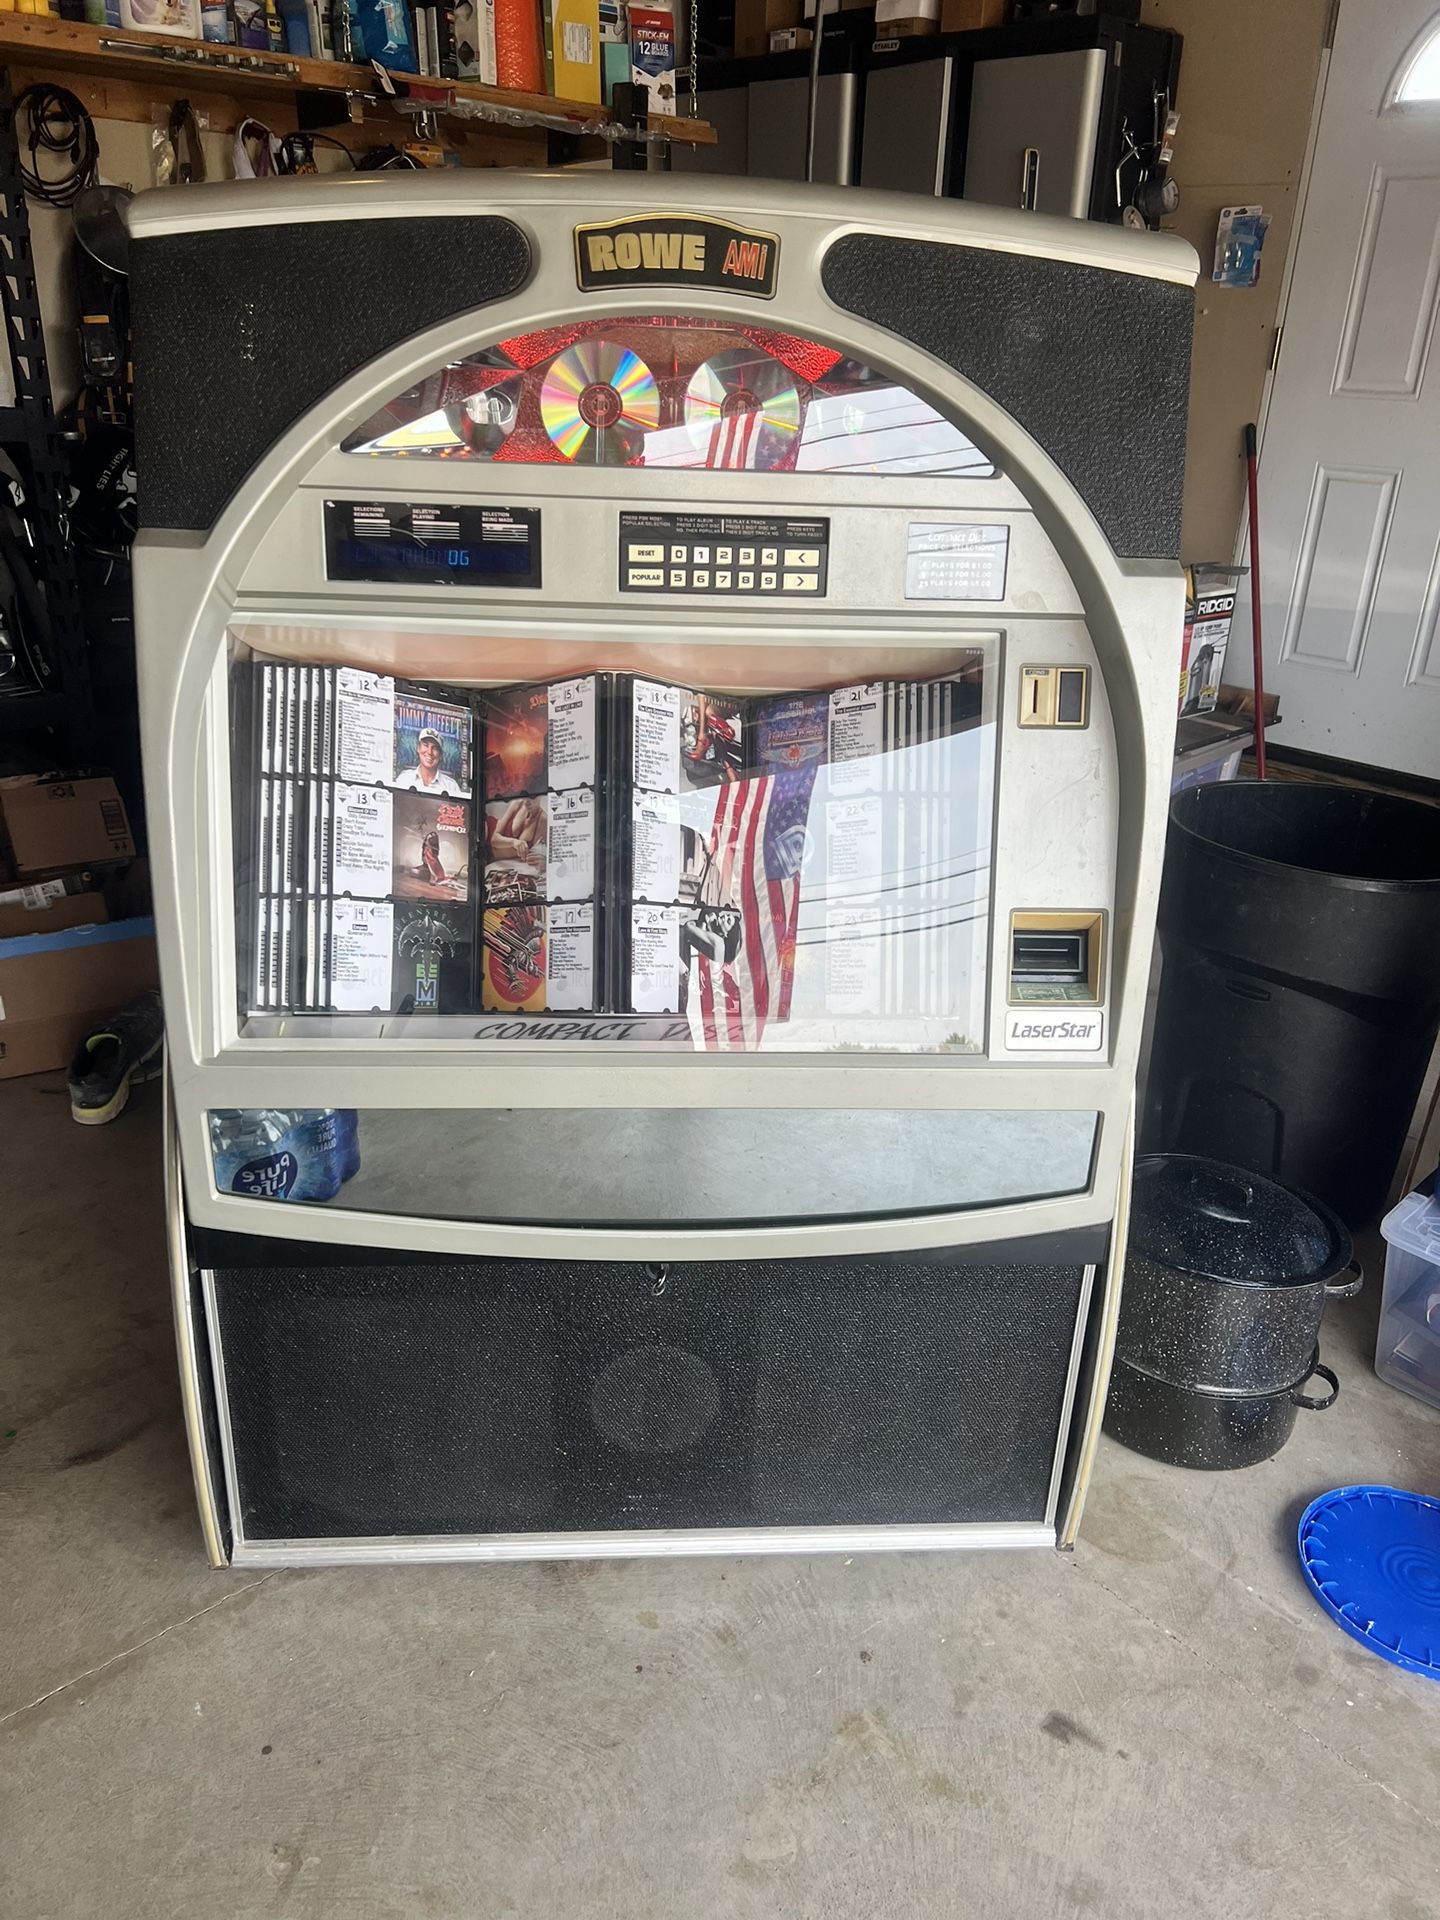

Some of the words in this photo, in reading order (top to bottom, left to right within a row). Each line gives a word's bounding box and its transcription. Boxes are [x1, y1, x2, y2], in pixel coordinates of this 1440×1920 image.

[639, 41, 651, 55] 12
[651, 43, 669, 51] GLUE
[587, 233, 706, 272] ROWE
[96, 470, 112, 491] LIES
[699, 551, 704, 560] 1
[720, 551, 729, 559] 2
[742, 552, 751, 560] 3
[765, 552, 774, 560] 4
[674, 574, 682, 582] 5
[697, 575, 705, 583] 6
[719, 575, 728, 584] 7
[742, 576, 750, 584] 8
[765, 576, 773, 585] 9
[1197, 597, 1234, 615] RIDGID
[360, 680, 370, 691] 12
[565, 689, 572, 700] 15
[851, 690, 861, 701] 21
[397, 707, 425, 729] JIMMY
[427, 712, 461, 740] BUFFETT
[358, 793, 368, 804] 13
[847, 805, 858, 816] 22
[648, 912, 658, 923] 20
[474, 1021, 648, 1041] COMPACT
[1011, 1022, 1096, 1038] LaserStar
